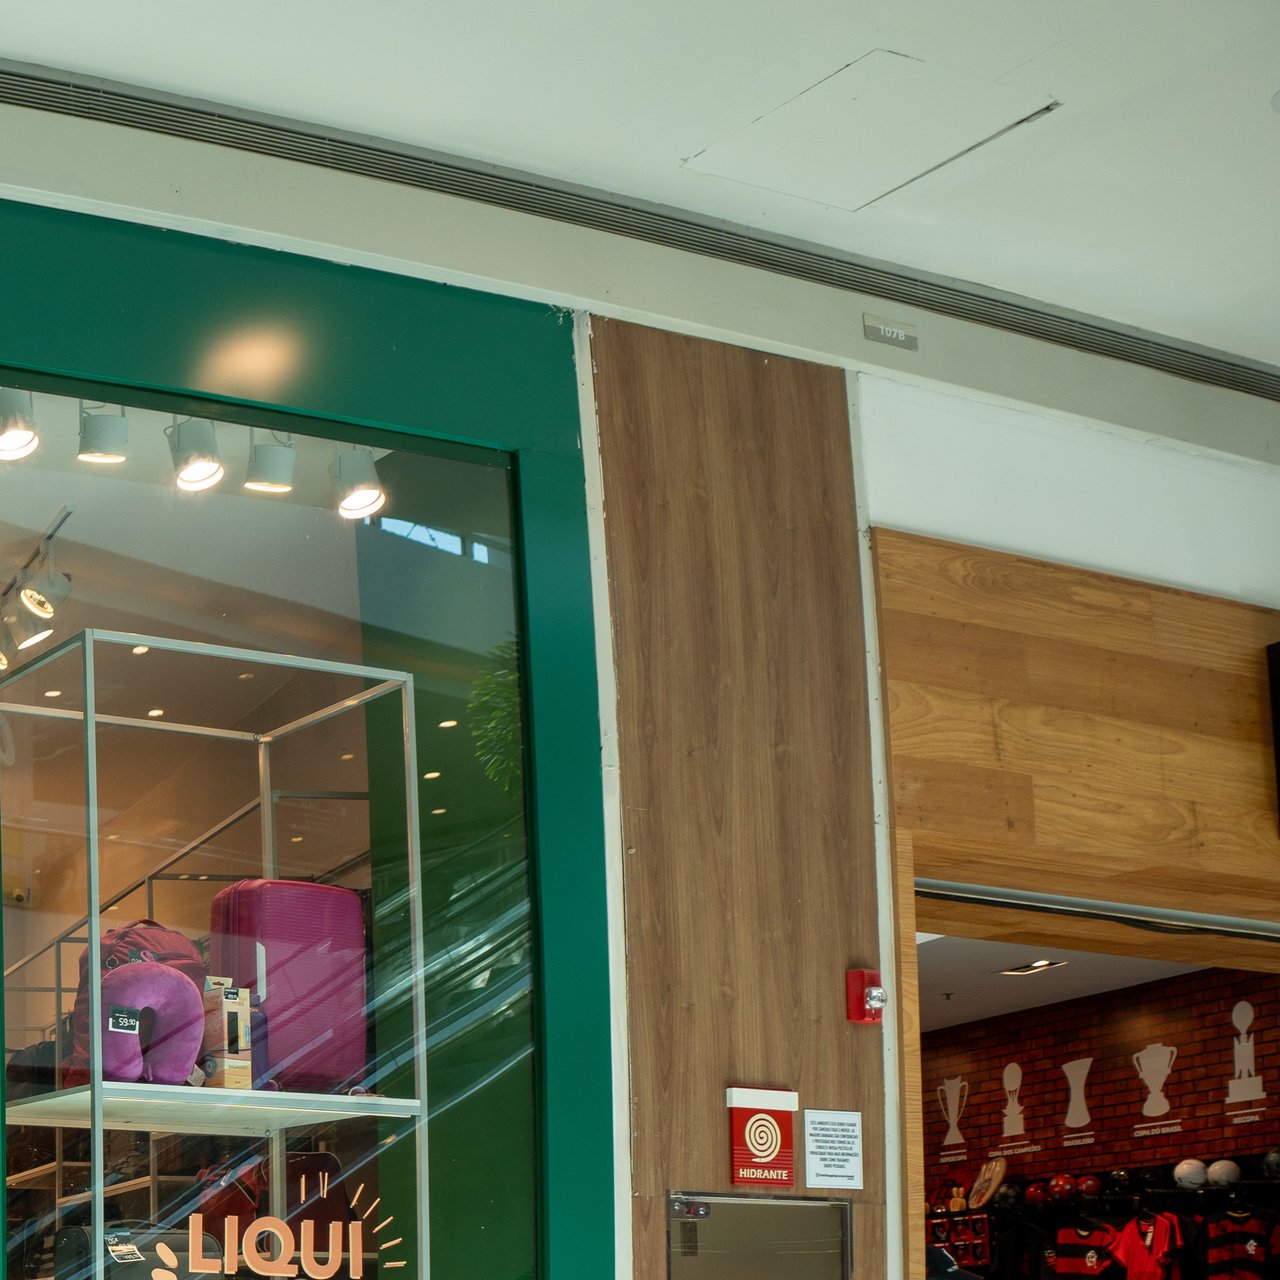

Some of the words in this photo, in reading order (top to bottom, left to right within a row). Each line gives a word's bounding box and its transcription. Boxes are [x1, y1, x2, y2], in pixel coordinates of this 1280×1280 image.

[880, 326, 906, 341] 107B
[739, 1168, 789, 1180] HIDRANTE
[189, 1213, 363, 1279] LIQUI
